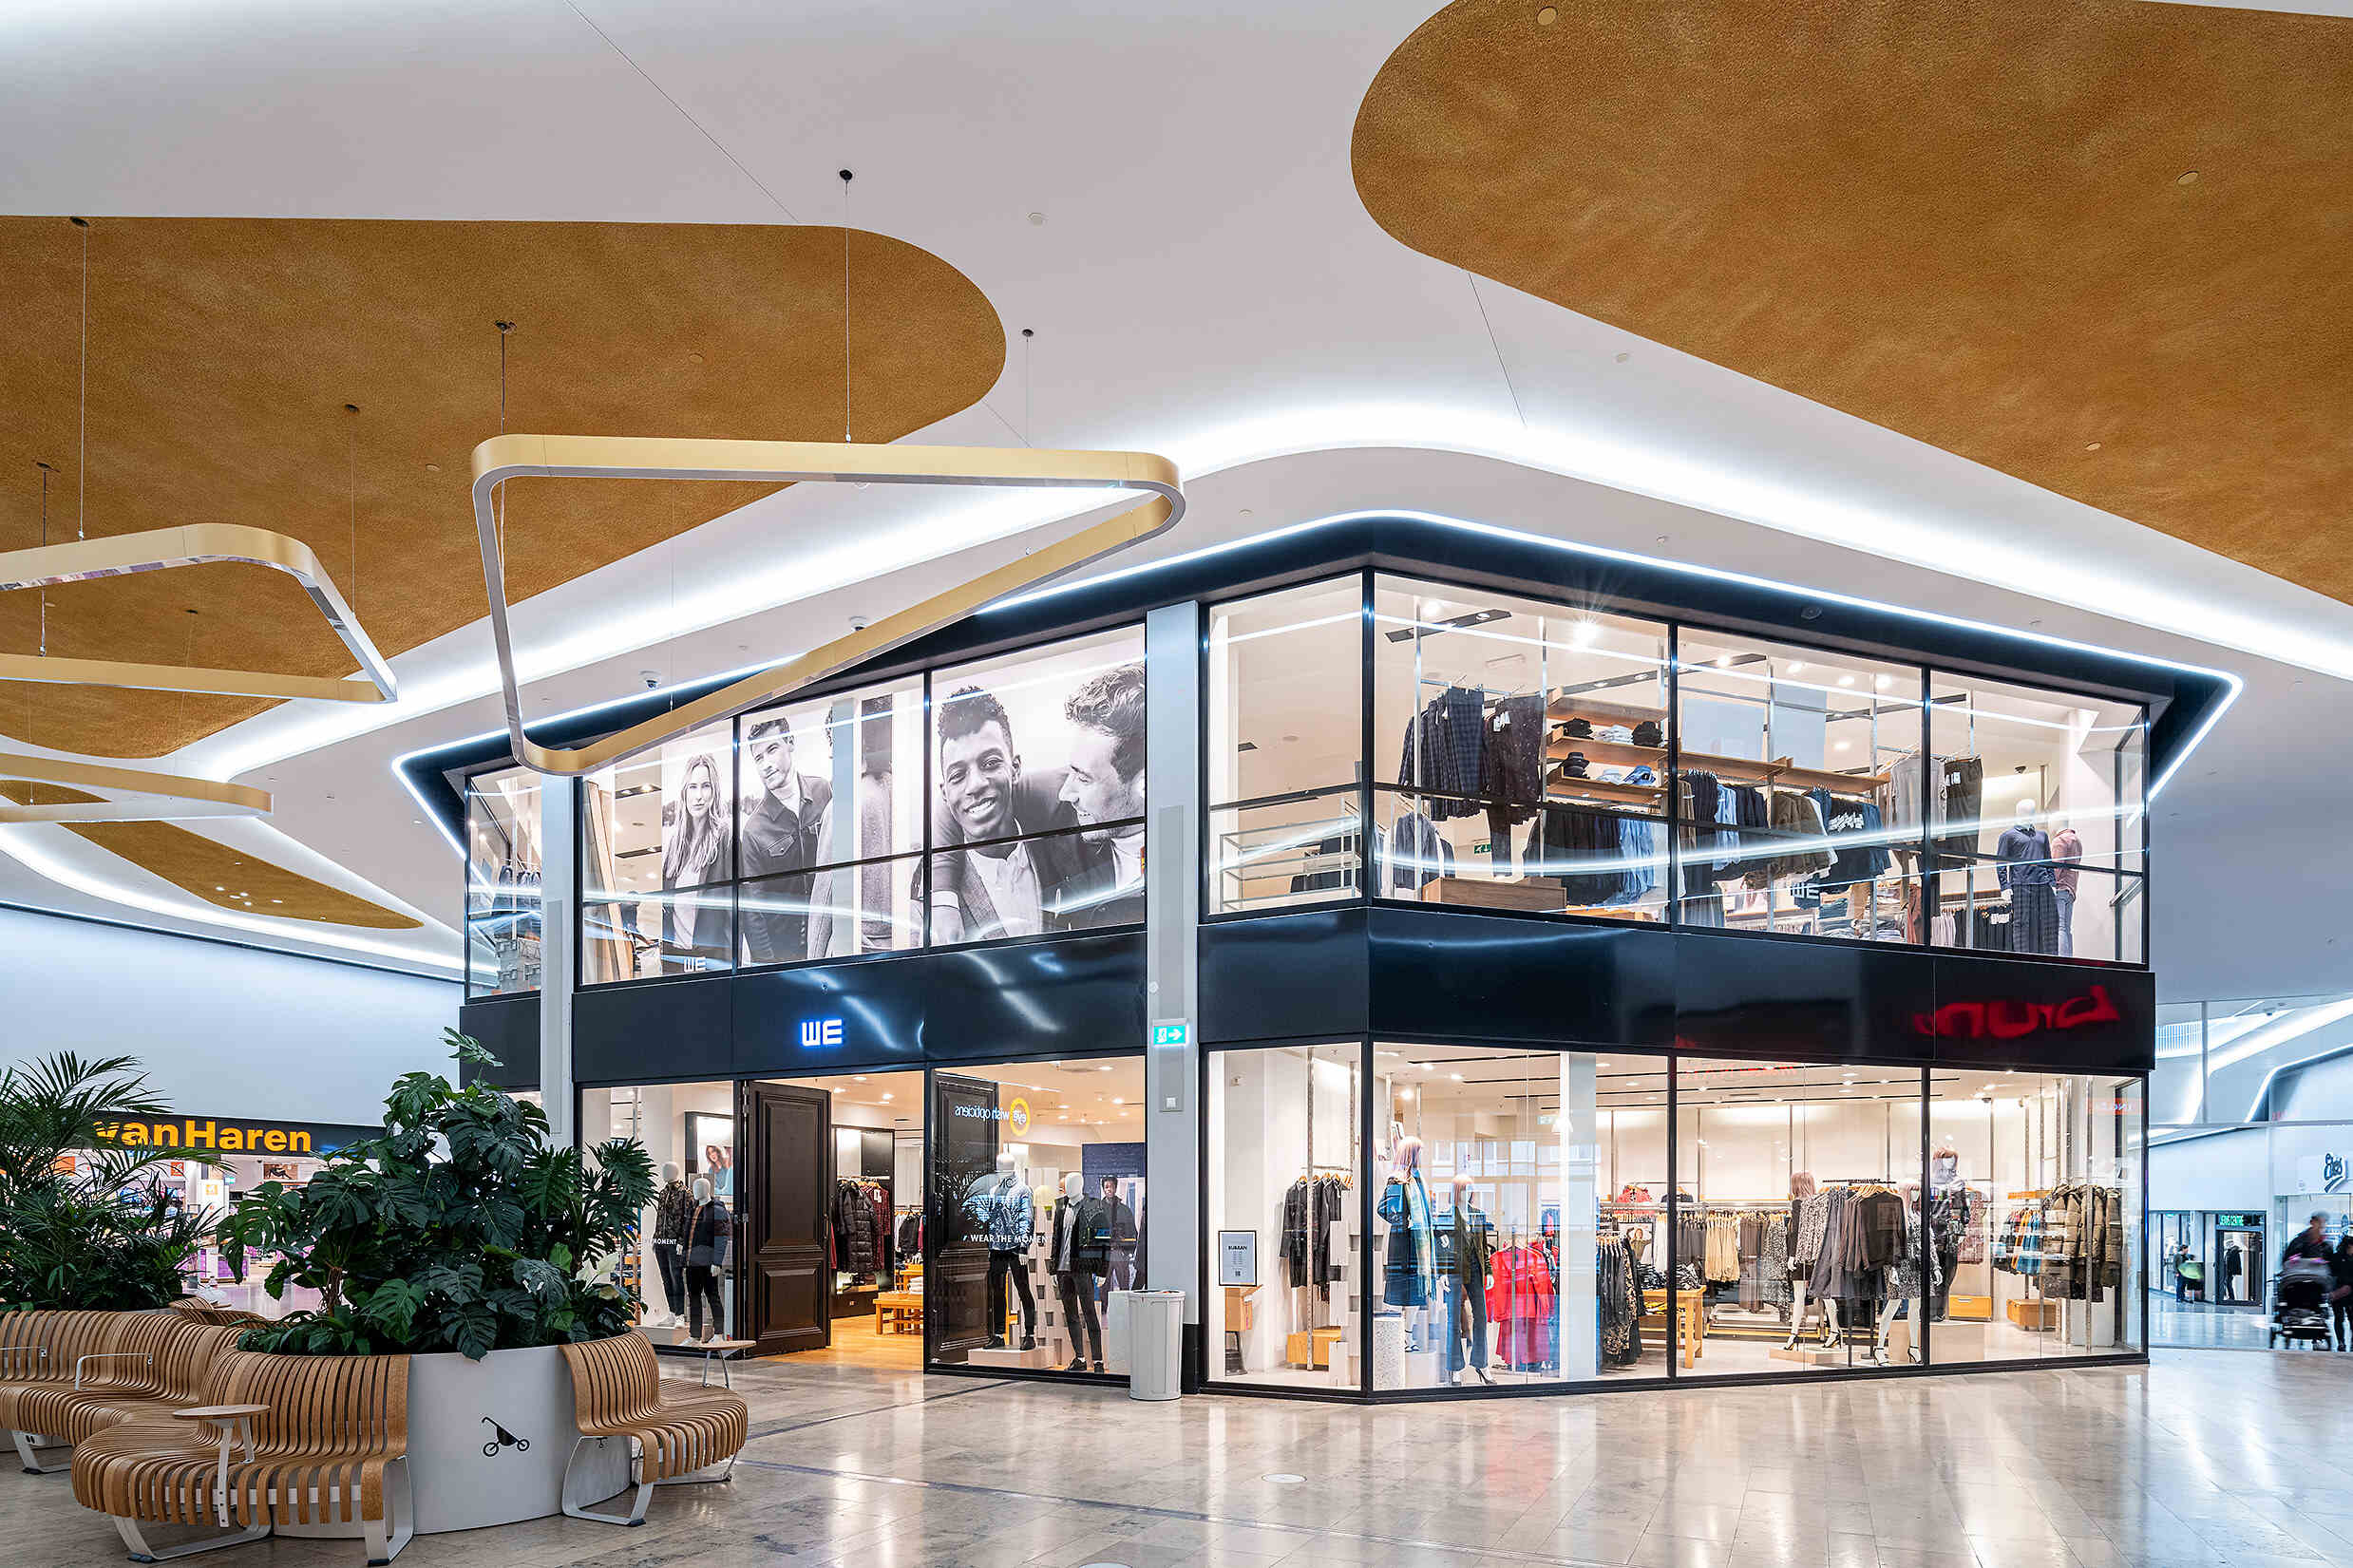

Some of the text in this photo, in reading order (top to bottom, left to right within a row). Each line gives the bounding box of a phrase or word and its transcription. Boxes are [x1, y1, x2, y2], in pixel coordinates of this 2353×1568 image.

[684, 956, 707, 973] WE
[802, 1019, 843, 1047] WE
[970, 1234, 995, 1243] WEAR
[996, 1234, 1012, 1243] THE
